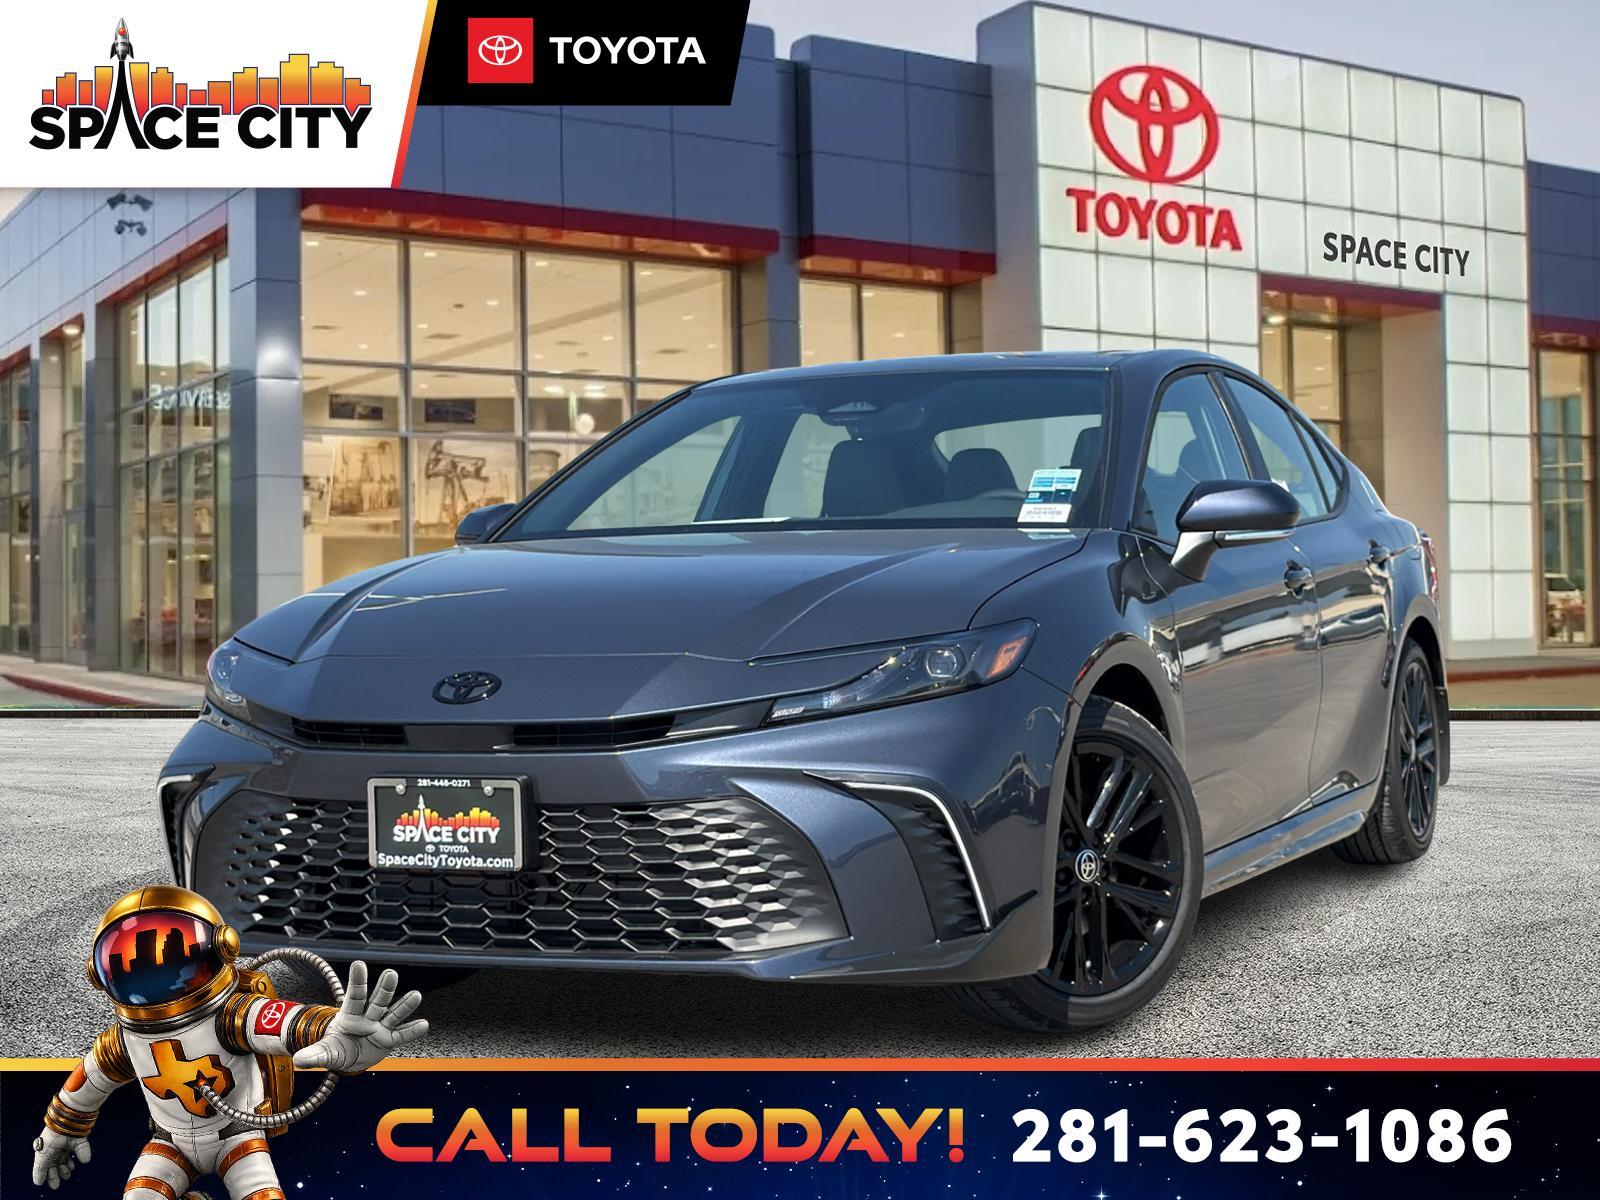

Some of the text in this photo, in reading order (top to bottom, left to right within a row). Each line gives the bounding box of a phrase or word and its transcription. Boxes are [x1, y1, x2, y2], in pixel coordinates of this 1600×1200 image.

[1066, 187, 1243, 252] TOYOTA
[1323, 231, 1470, 277] SPACE CITY
[393, 824, 500, 843] SPACE CITY
[439, 844, 469, 853] TOYOTA
[378, 852, 514, 869] SpaceCityToyota.com
